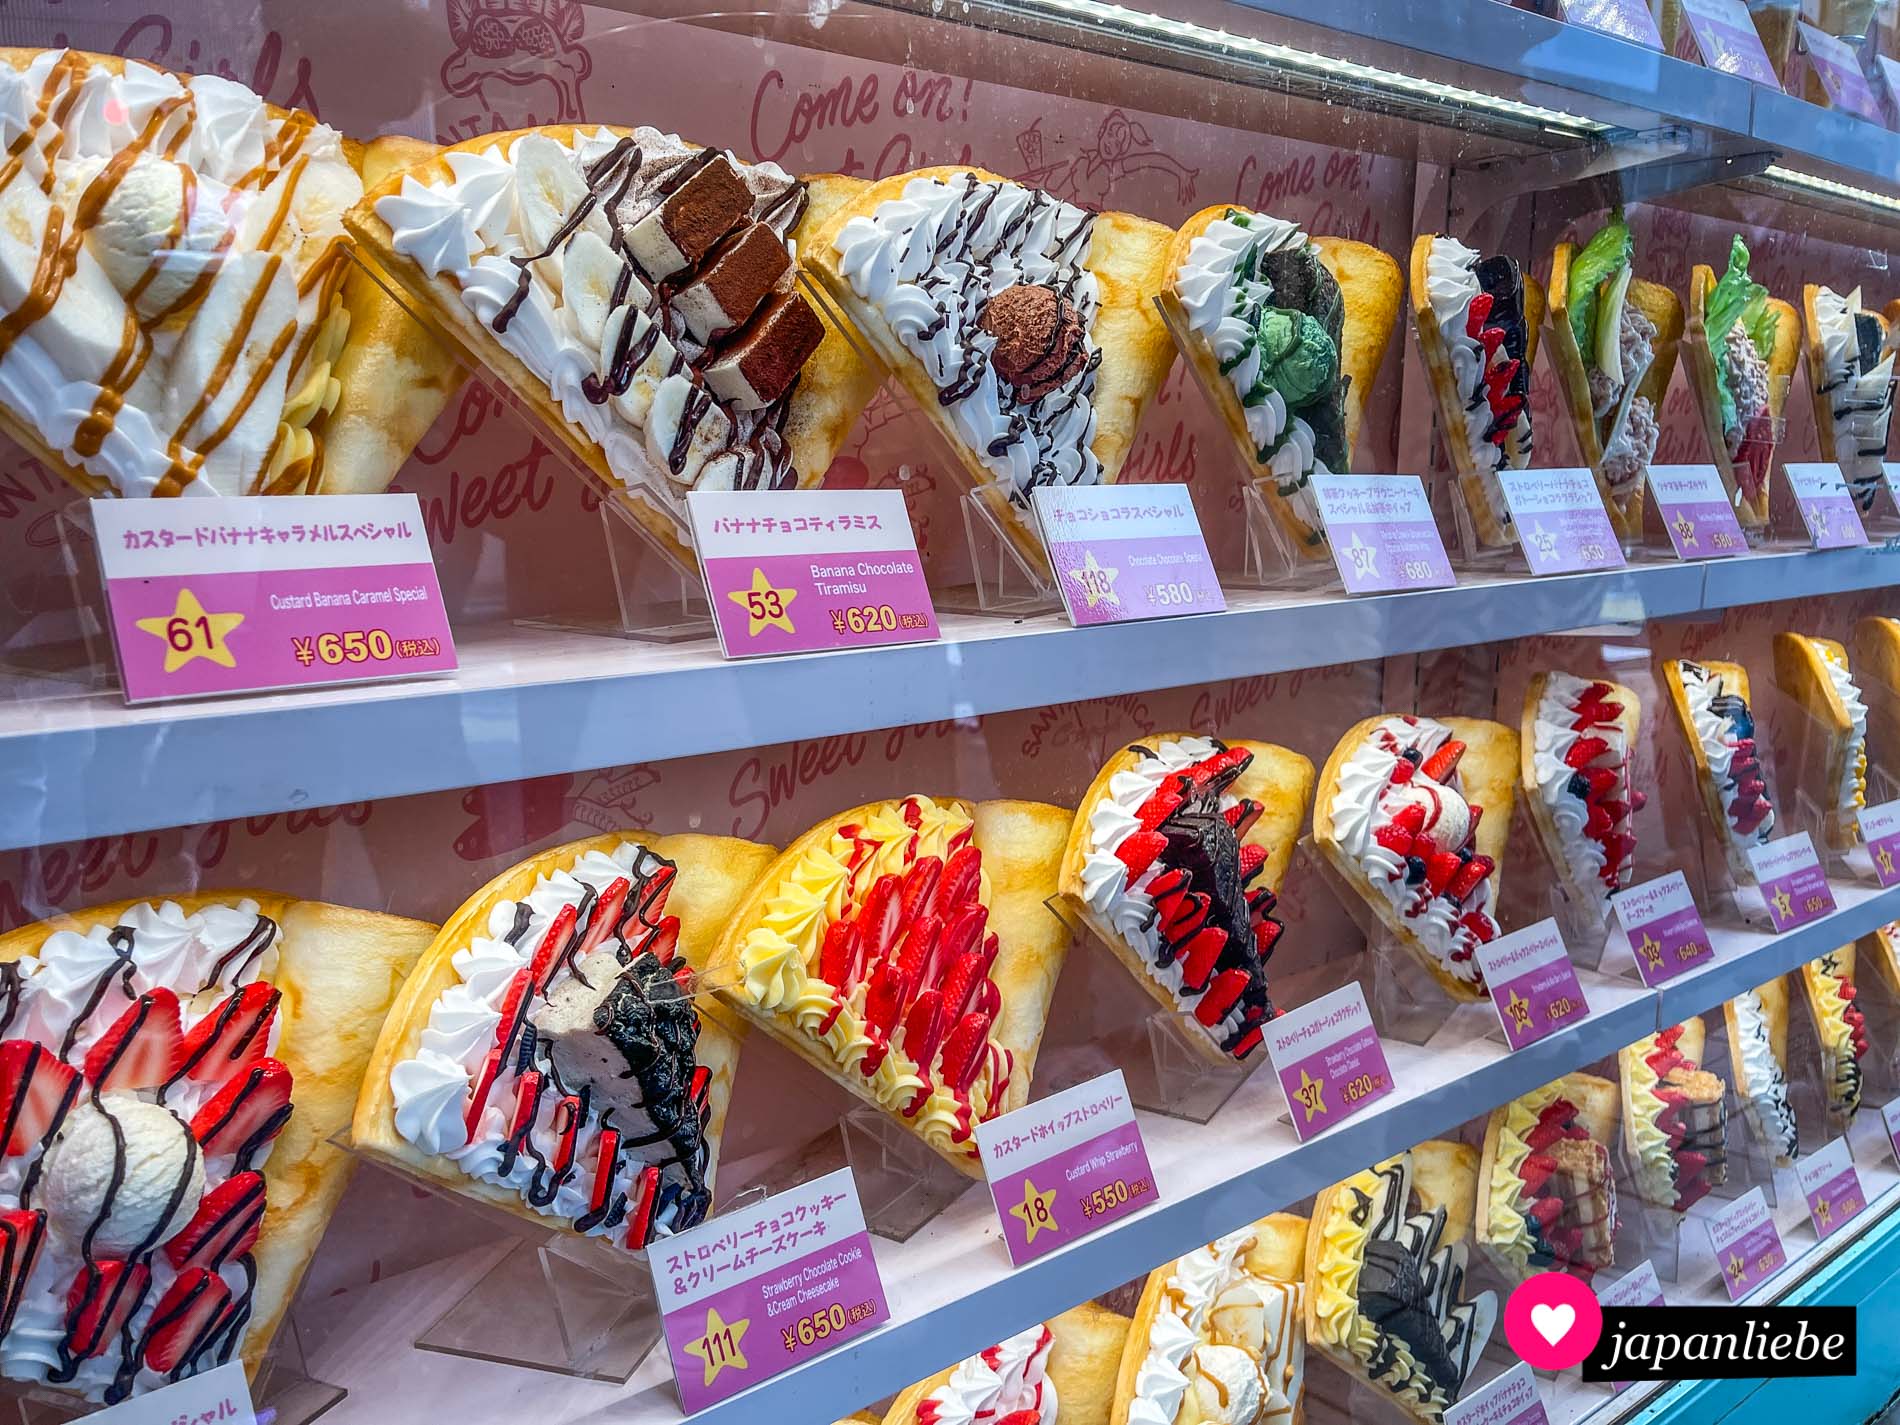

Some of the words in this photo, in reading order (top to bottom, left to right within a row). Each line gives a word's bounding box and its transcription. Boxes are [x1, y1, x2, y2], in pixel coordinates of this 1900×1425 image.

[1122, 421, 1196, 482] irls
[423, 436, 555, 544] weet
[714, 515, 882, 534] バナナチョコティラミス
[1053, 504, 1185, 523] チョコショコラスペシャル
[123, 521, 412, 550] カスタードバナナキャラメルスペシャル
[810, 564, 855, 578] Banana
[857, 561, 914, 576] Chocolate
[270, 593, 312, 611] Custard
[314, 591, 351, 607] Banana
[352, 589, 392, 605] Caramel
[393, 586, 428, 603] Special
[747, 589, 784, 620] 53
[814, 582, 867, 596] Tiramisu
[167, 616, 215, 652] 61
[1509, 1001, 1528, 1024] 105
[1301, 1084, 1319, 1109] 37
[993, 1094, 1123, 1160] カスタードホイップストロベリー
[1066, 1161, 1091, 1181] Custard
[1090, 1153, 1107, 1171] Whip
[1106, 1140, 1138, 1164] Strawberry
[1023, 1197, 1049, 1228] 18
[667, 1193, 847, 1275] ストロベリーチョコクッキー
[674, 1220, 828, 1296] &クリームチーズケーキ
[762, 1271, 803, 1300] Strawberry
[802, 1258, 839, 1283] Chocolate
[838, 1246, 863, 1268] Cookie
[767, 1294, 804, 1317] &Cream
[799, 1277, 840, 1304] Cheesecake
[702, 1327, 737, 1367] 111
